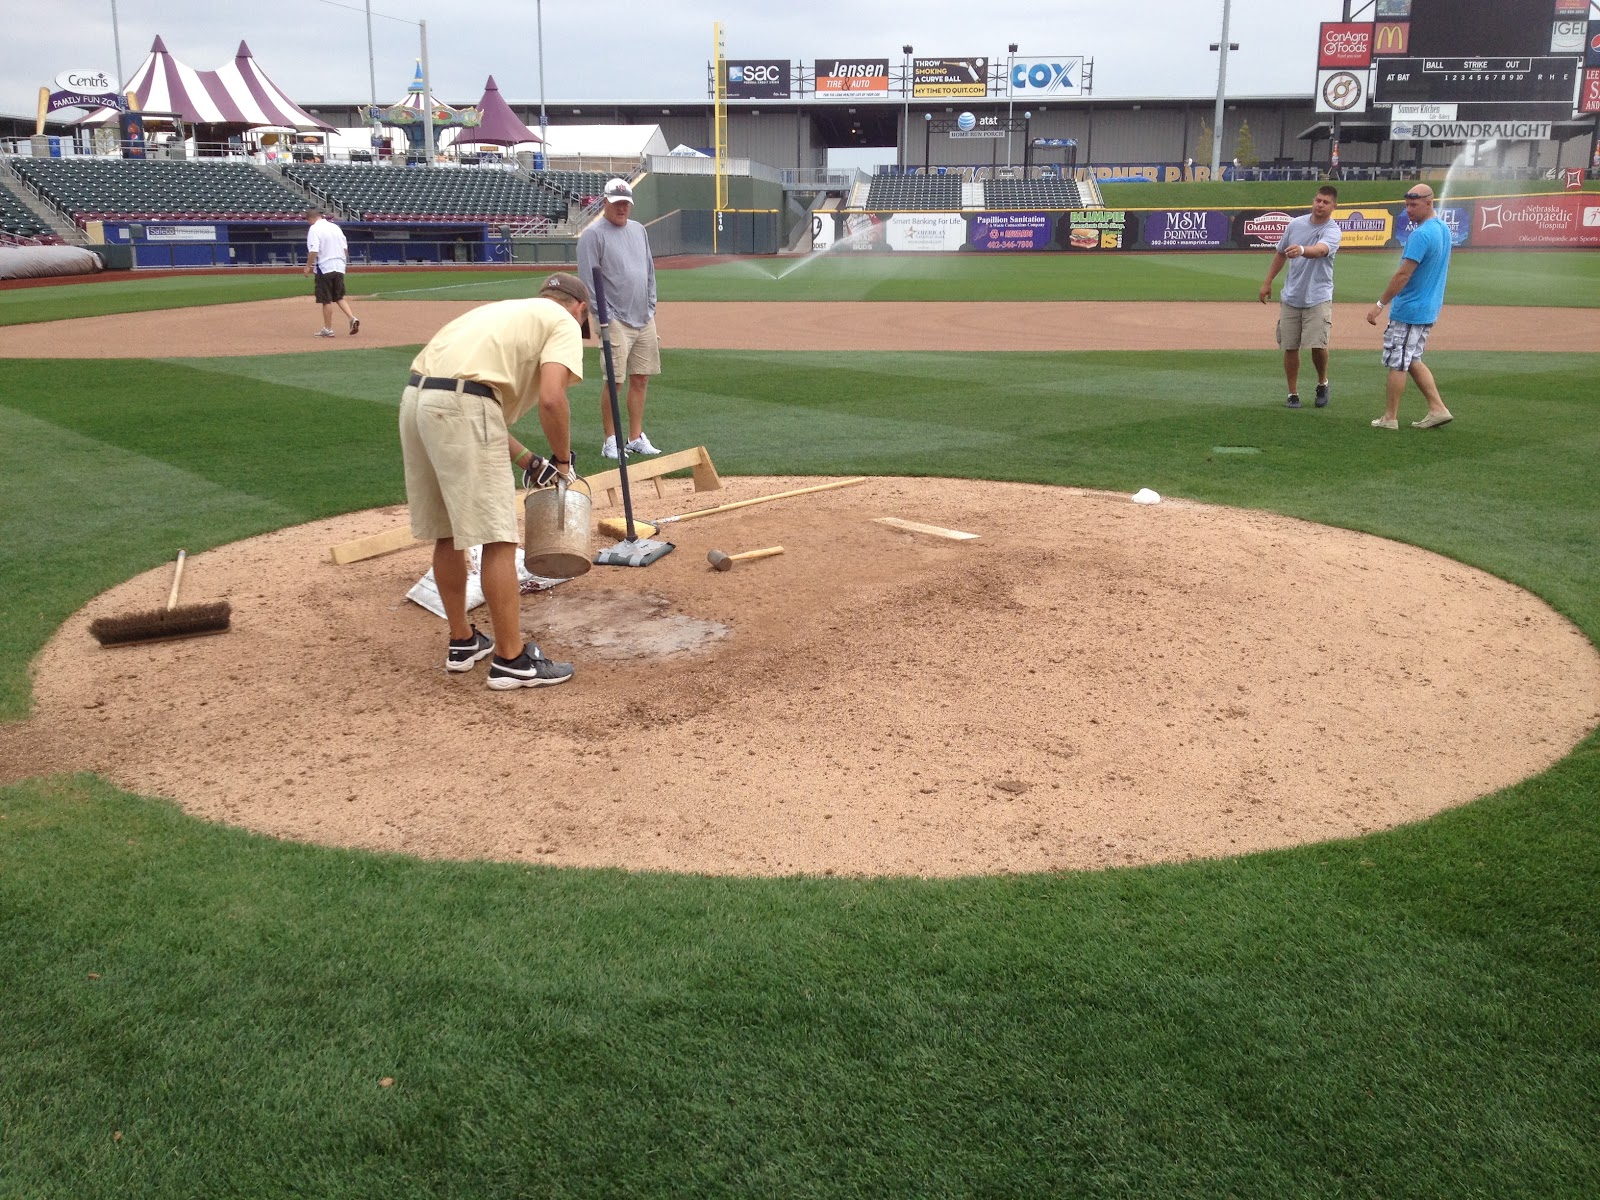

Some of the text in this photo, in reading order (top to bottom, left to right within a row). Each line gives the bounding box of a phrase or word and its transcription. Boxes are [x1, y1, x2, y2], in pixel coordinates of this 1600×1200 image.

[1554, 22, 1586, 35] IGEL
[1326, 31, 1368, 45] ConAgra
[1337, 41, 1367, 53] Foods
[828, 61, 884, 77] Jensen
[1426, 61, 1444, 69] BALL
[1464, 60, 1488, 68] STRIKE
[1505, 60, 1520, 68] OUT
[743, 65, 780, 81] sac
[1010, 61, 1076, 91] COX
[1397, 73, 1410, 81] BAT
[68, 73, 109, 87] Centris
[841, 77, 851, 91] &
[1590, 81, 1600, 99] S
[53, 95, 121, 110] FAMILY FUN ZON
[1397, 104, 1440, 114] Summer Kitchen
[979, 116, 998, 125] at&t
[1411, 124, 1420, 136] THE
[1418, 123, 1551, 138] DOWNDRAUGHT
[1165, 166, 1228, 182] PARK
[1526, 205, 1560, 213] Nebraska
[912, 218, 937, 226] Banking
[977, 215, 1046, 225] Papillion Sanitation
[1070, 211, 1126, 223] BLIMPIE
[1165, 211, 1208, 230] MSM
[1502, 209, 1573, 225] Orthopaedic
[1247, 223, 1275, 231] OMAHA
[1353, 220, 1385, 229] UNIVERSITY
[1538, 221, 1568, 231] Hospital
[150, 226, 175, 235] Safeco
[1163, 230, 1208, 240] PRINTING
[1538, 235, 1568, 243] Orthopaedic
[1579, 235, 1598, 243] Sports
